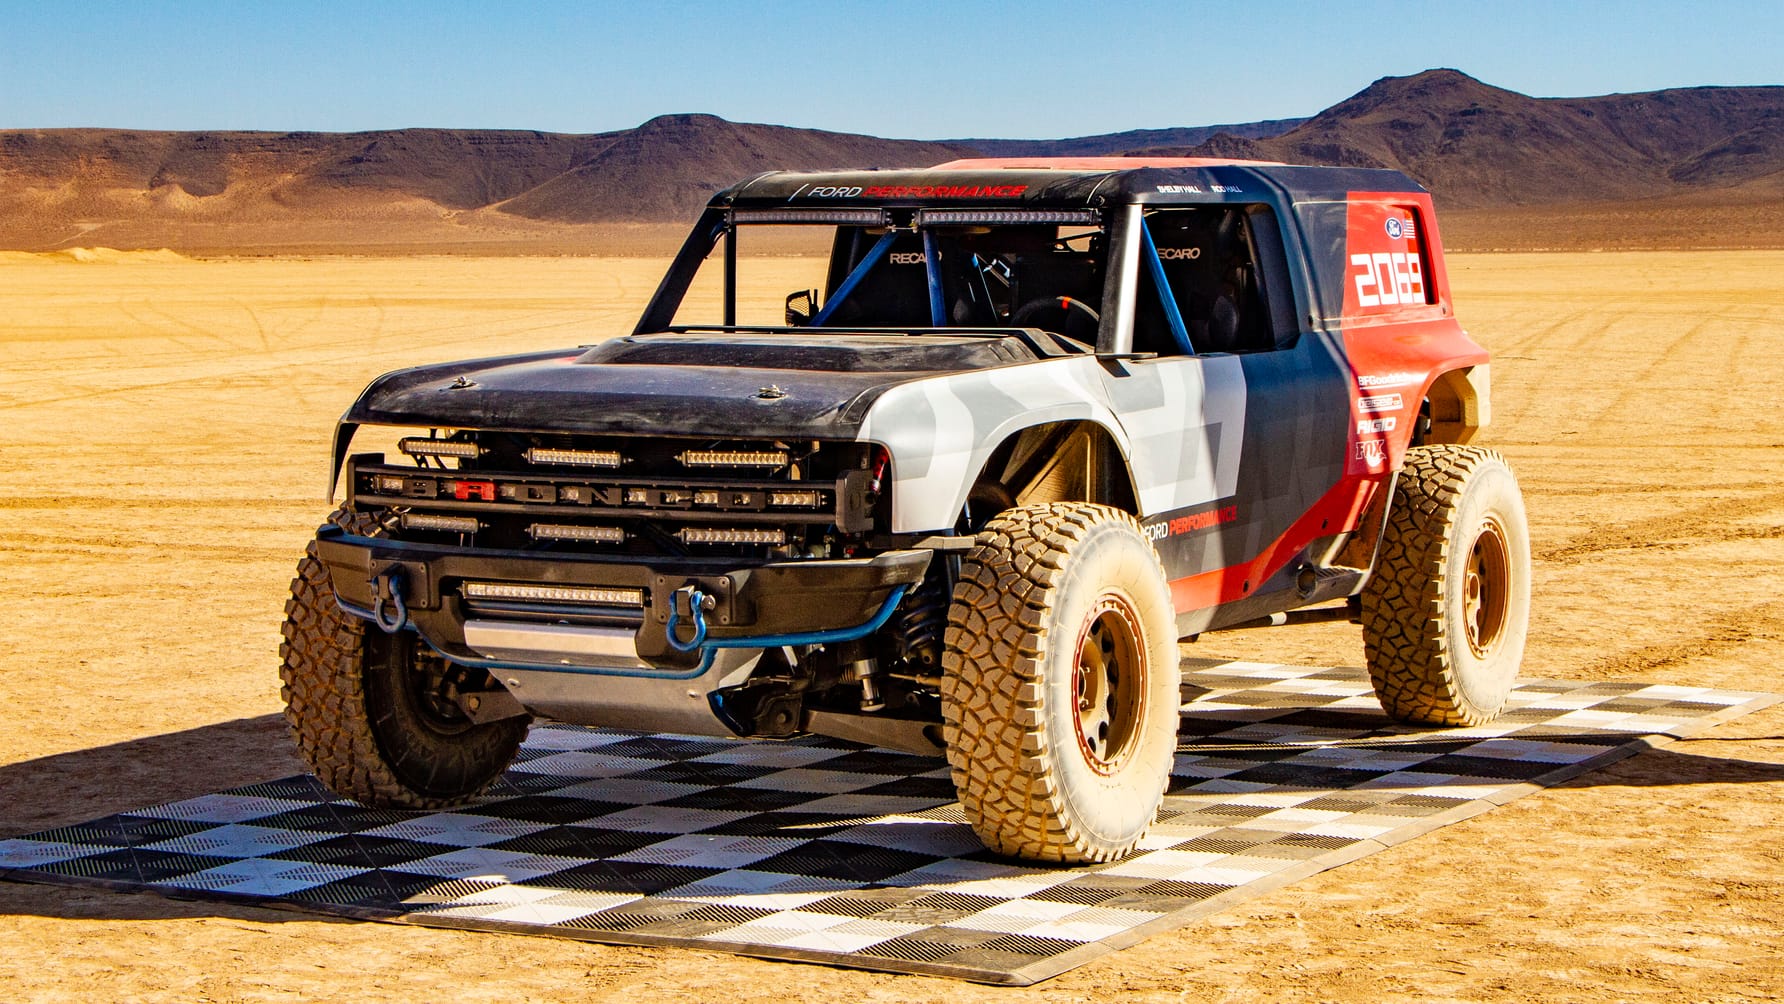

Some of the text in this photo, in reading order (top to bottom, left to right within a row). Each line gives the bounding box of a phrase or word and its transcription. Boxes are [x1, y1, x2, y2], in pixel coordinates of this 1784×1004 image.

[808, 185, 1029, 198] FORD PERFORMANCE
[1182, 185, 1202, 194] HALL
[1225, 185, 1243, 194] HALL
[889, 250, 943, 264] RECA
[1157, 247, 1201, 260] ECARO
[1351, 252, 1426, 307] 2069
[1357, 417, 1397, 434] RIGID
[1355, 439, 1387, 464] FOX
[402, 479, 766, 510] BRONCO
[1144, 505, 1237, 541] FORD PERFORMANCE
